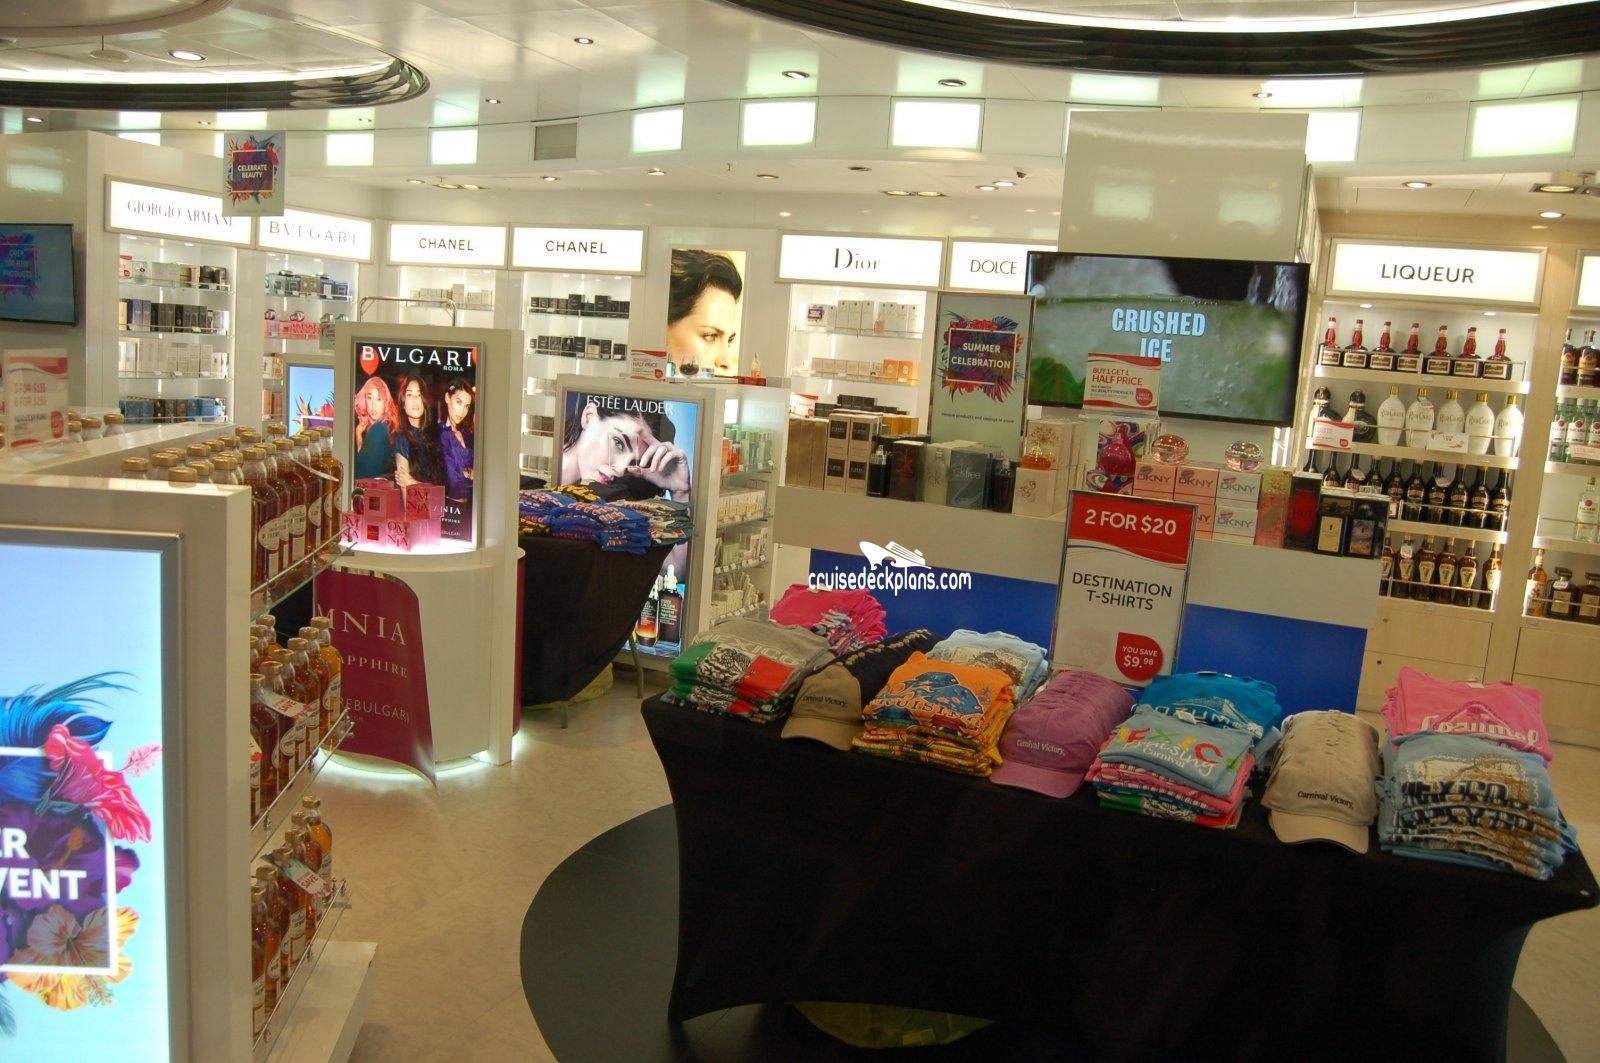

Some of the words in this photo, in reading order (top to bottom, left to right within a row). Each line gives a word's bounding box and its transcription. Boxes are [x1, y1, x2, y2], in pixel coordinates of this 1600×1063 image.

[237, 163, 268, 172] CELEBRATE
[241, 171, 263, 179] BEAUTY
[127, 200, 181, 219] GIORGIO
[269, 220, 358, 245] BVLGARI
[418, 237, 475, 252] CHANEL
[545, 240, 608, 254] CHANEL
[834, 247, 881, 271] Dior
[970, 259, 1017, 275] DOLCE
[1380, 263, 1475, 284] LIQUEUR
[1111, 307, 1206, 337] CRUSHED
[962, 342, 1001, 354] SUMMER
[1139, 337, 1173, 363] ICE
[361, 345, 473, 368] BVLGARI
[951, 356, 1011, 369] CELEBRATION
[443, 364, 465, 372] ROMA
[1092, 367, 1106, 375] BUY
[1111, 368, 1124, 376] GET
[1092, 374, 1115, 384] HALF
[1116, 376, 1143, 386] PRICE
[624, 399, 673, 415] LAUDER
[1136, 473, 1171, 483] DKNY
[1178, 476, 1214, 488] DKNY
[1220, 482, 1256, 493] DKNY
[1084, 508, 1096, 526] 2
[1100, 510, 1137, 532] FOR
[1141, 514, 1178, 536] $20
[1217, 517, 1253, 528] DKNY
[1071, 571, 1173, 598] DESTINATION
[1086, 590, 1155, 611] T-SHIRTS
[1122, 645, 1139, 654] YOU
[1139, 648, 1158, 657] SAVE
[1123, 654, 1154, 668] $9.98
[1016, 738, 1040, 751] Carnival
[1041, 741, 1066, 756] Victory
[1297, 790, 1329, 804] Carnival
[1329, 794, 1354, 810] Victory
[0, 827, 30, 859] R
[0, 867, 87, 900] VENT
[300, 874, 319, 889] SAVE
